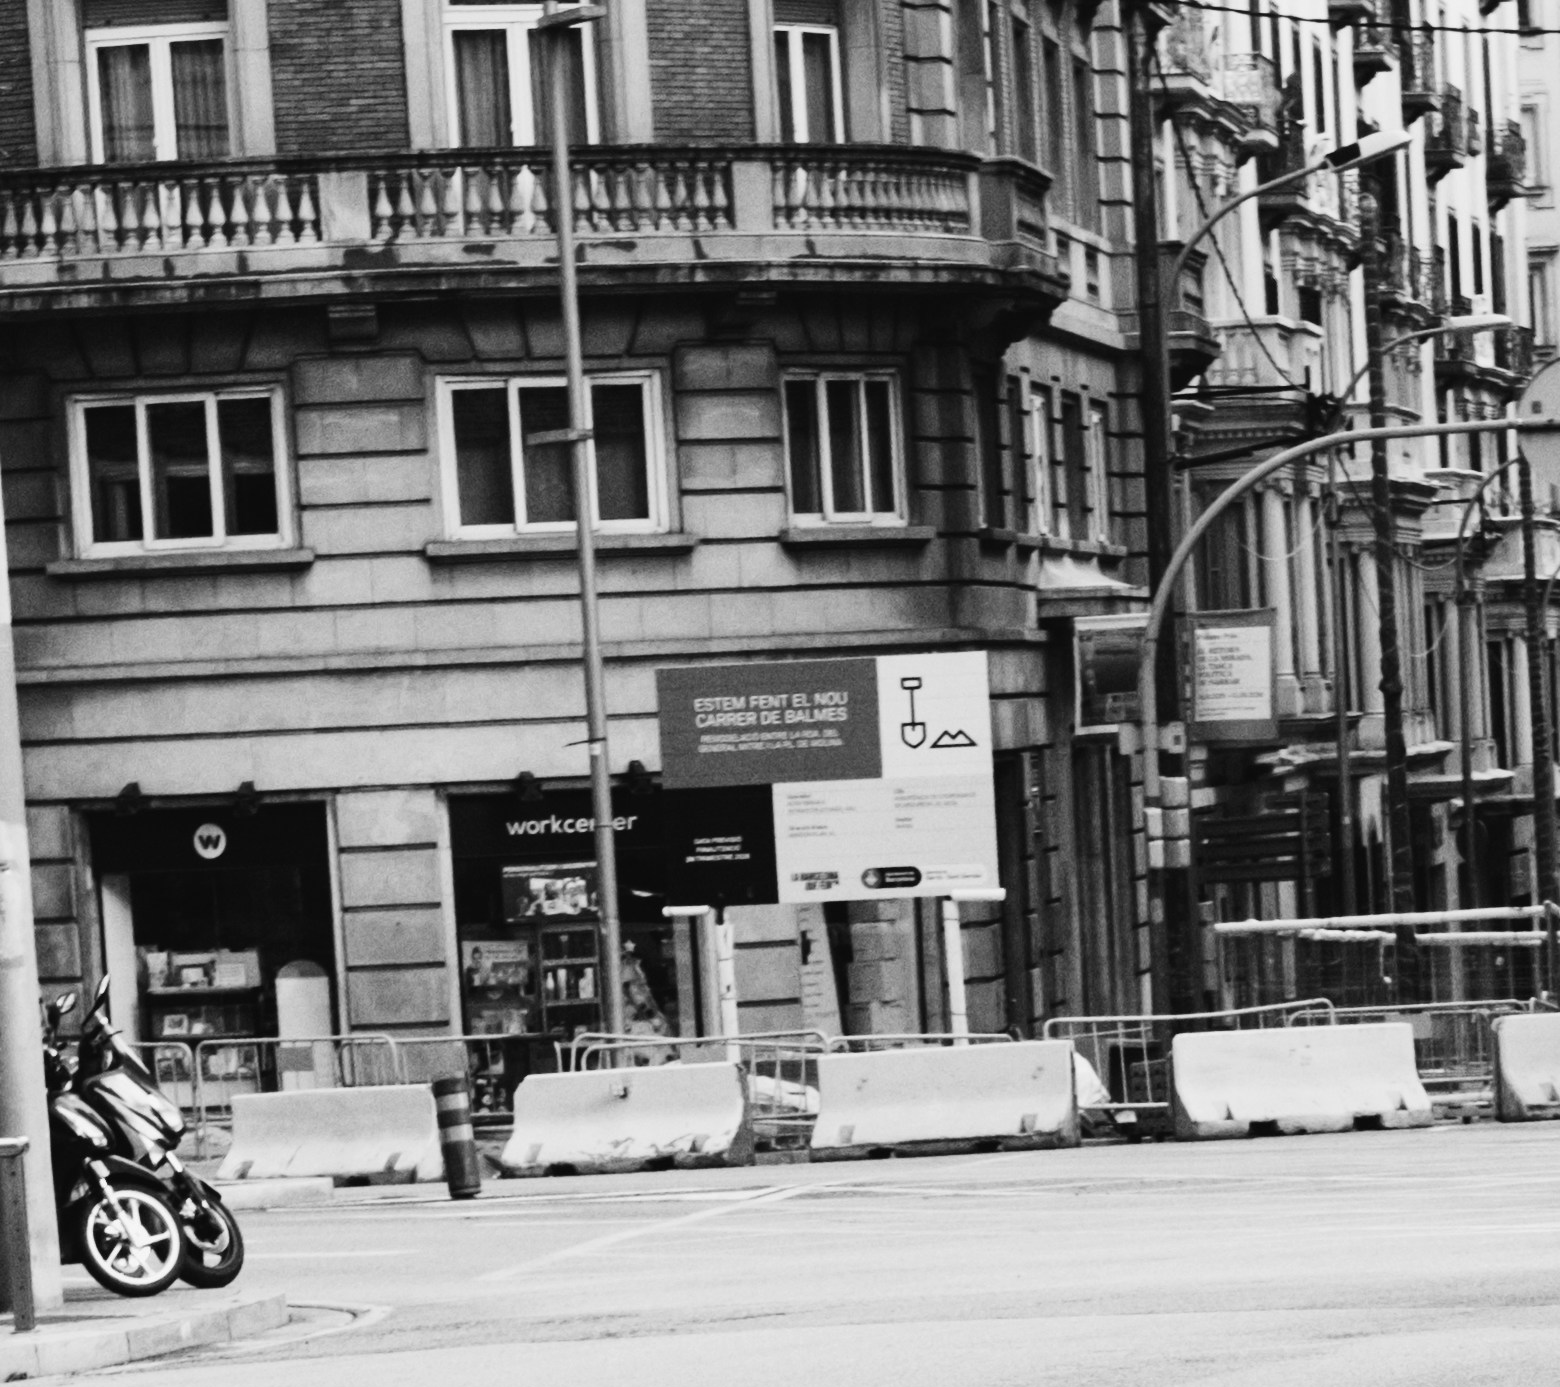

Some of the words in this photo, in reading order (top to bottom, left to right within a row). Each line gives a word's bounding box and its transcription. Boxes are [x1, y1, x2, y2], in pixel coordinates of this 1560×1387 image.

[694, 696, 747, 712] ESTEM
[749, 694, 789, 709] FENT
[792, 693, 811, 708] EL
[814, 691, 848, 706] NOU
[695, 711, 758, 728] CARRER
[760, 710, 783, 725] DE
[785, 707, 848, 724] BALMES
